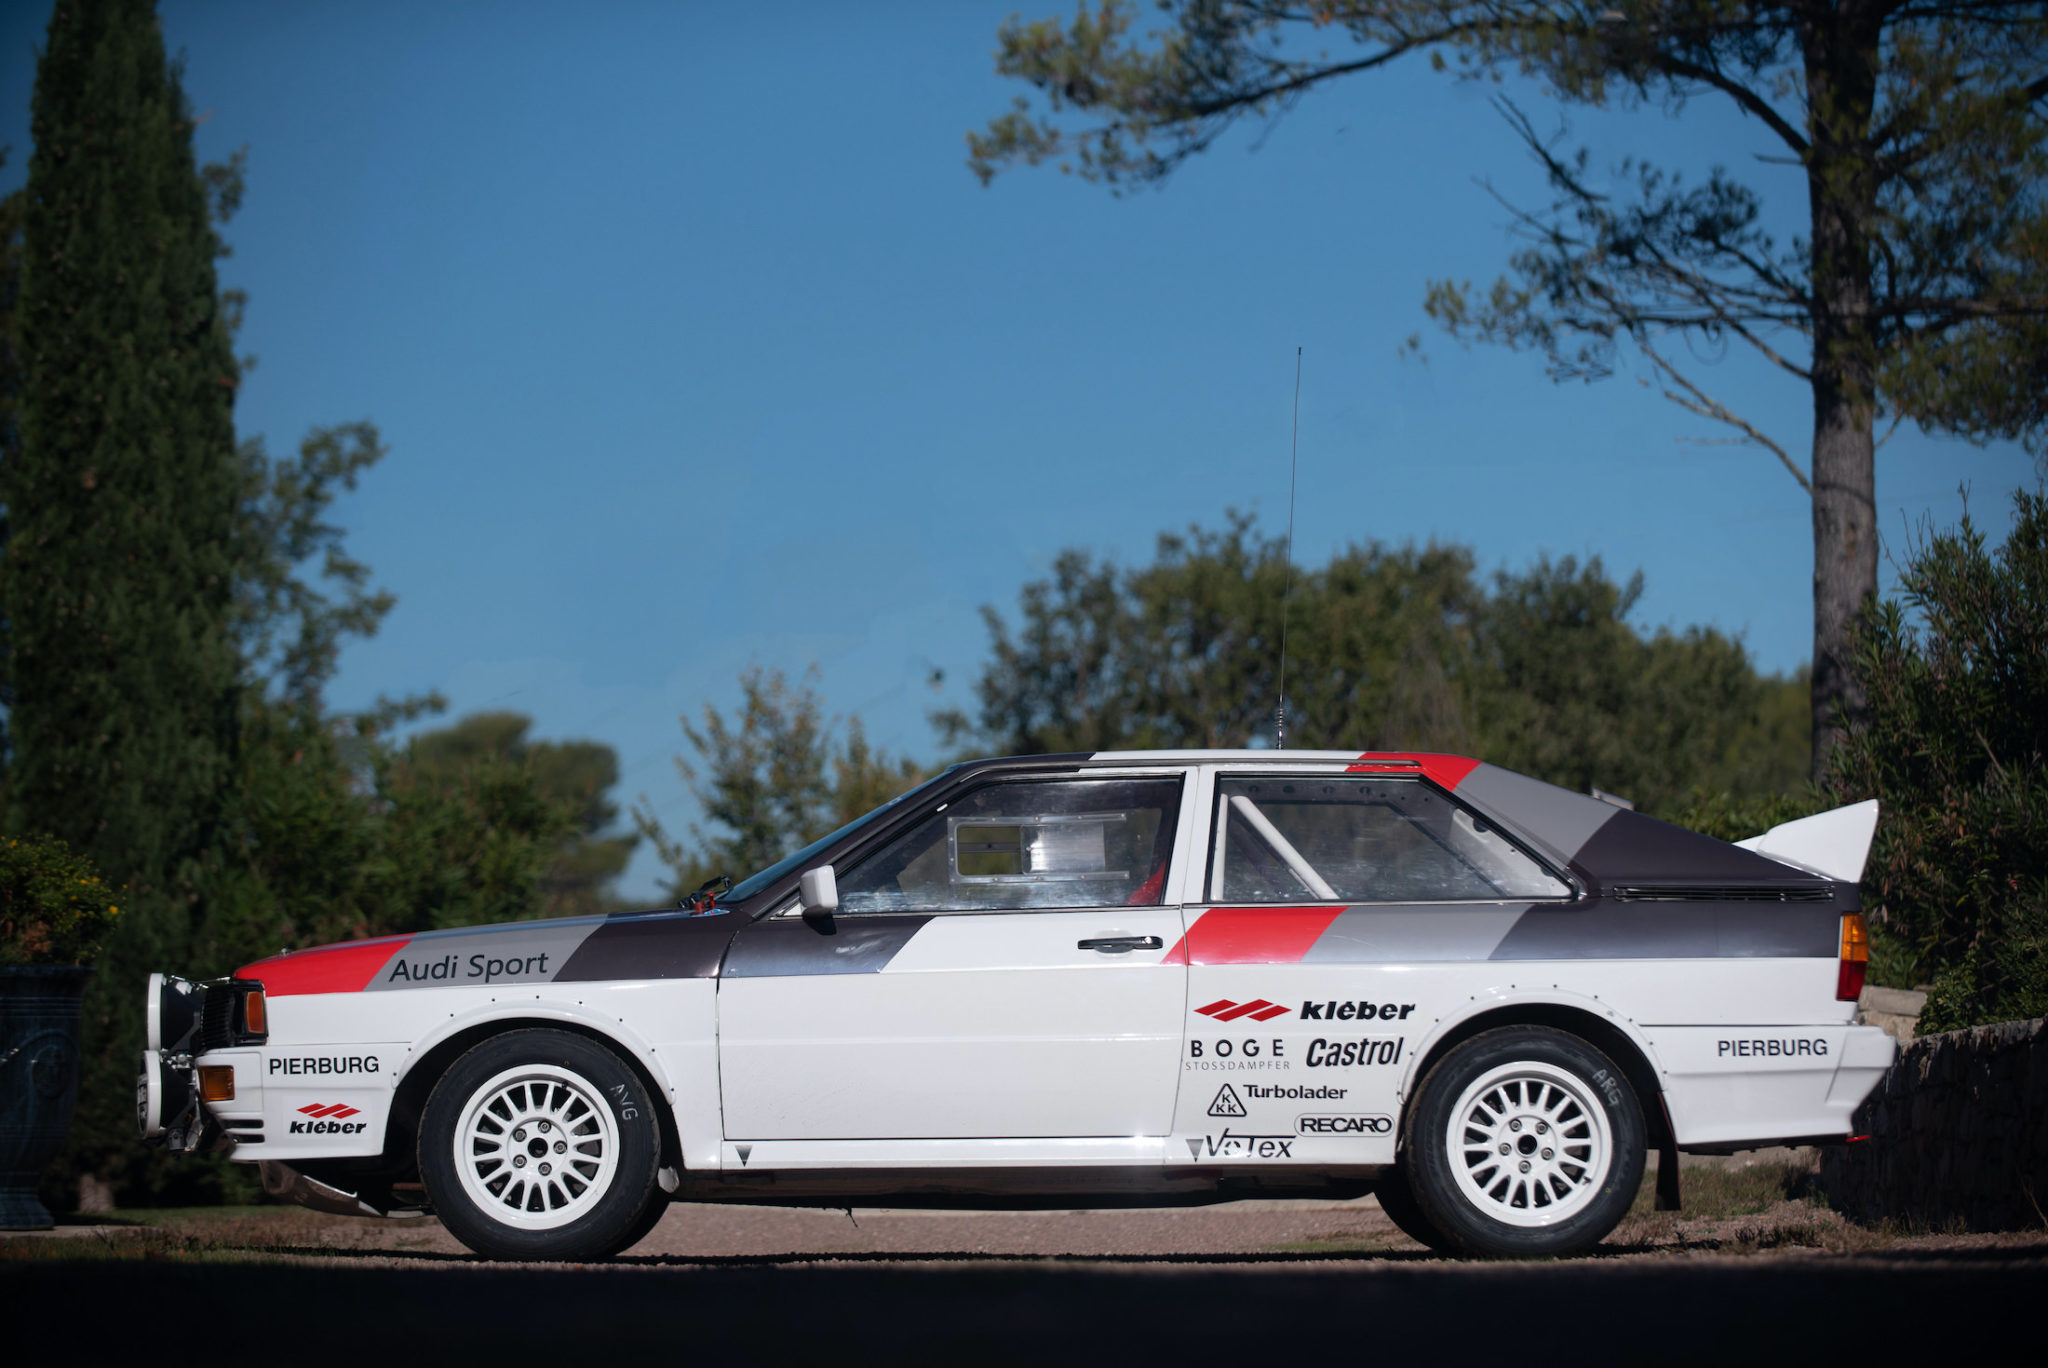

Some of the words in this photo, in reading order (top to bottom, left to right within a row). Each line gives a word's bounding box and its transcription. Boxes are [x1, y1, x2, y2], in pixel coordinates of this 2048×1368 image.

[389, 956, 458, 983] Audi
[467, 953, 548, 982] Sport
[1300, 1000, 1416, 1020] kléber
[1306, 1037, 1404, 1067] Castrol
[1717, 1038, 1828, 1057] PIERBURG
[269, 1056, 379, 1075] PIERBURG
[1243, 1084, 1347, 1099] Turbolader
[610, 1083, 638, 1120] AVG
[289, 1121, 367, 1134] kléber
[1300, 1117, 1392, 1133] RECARO
